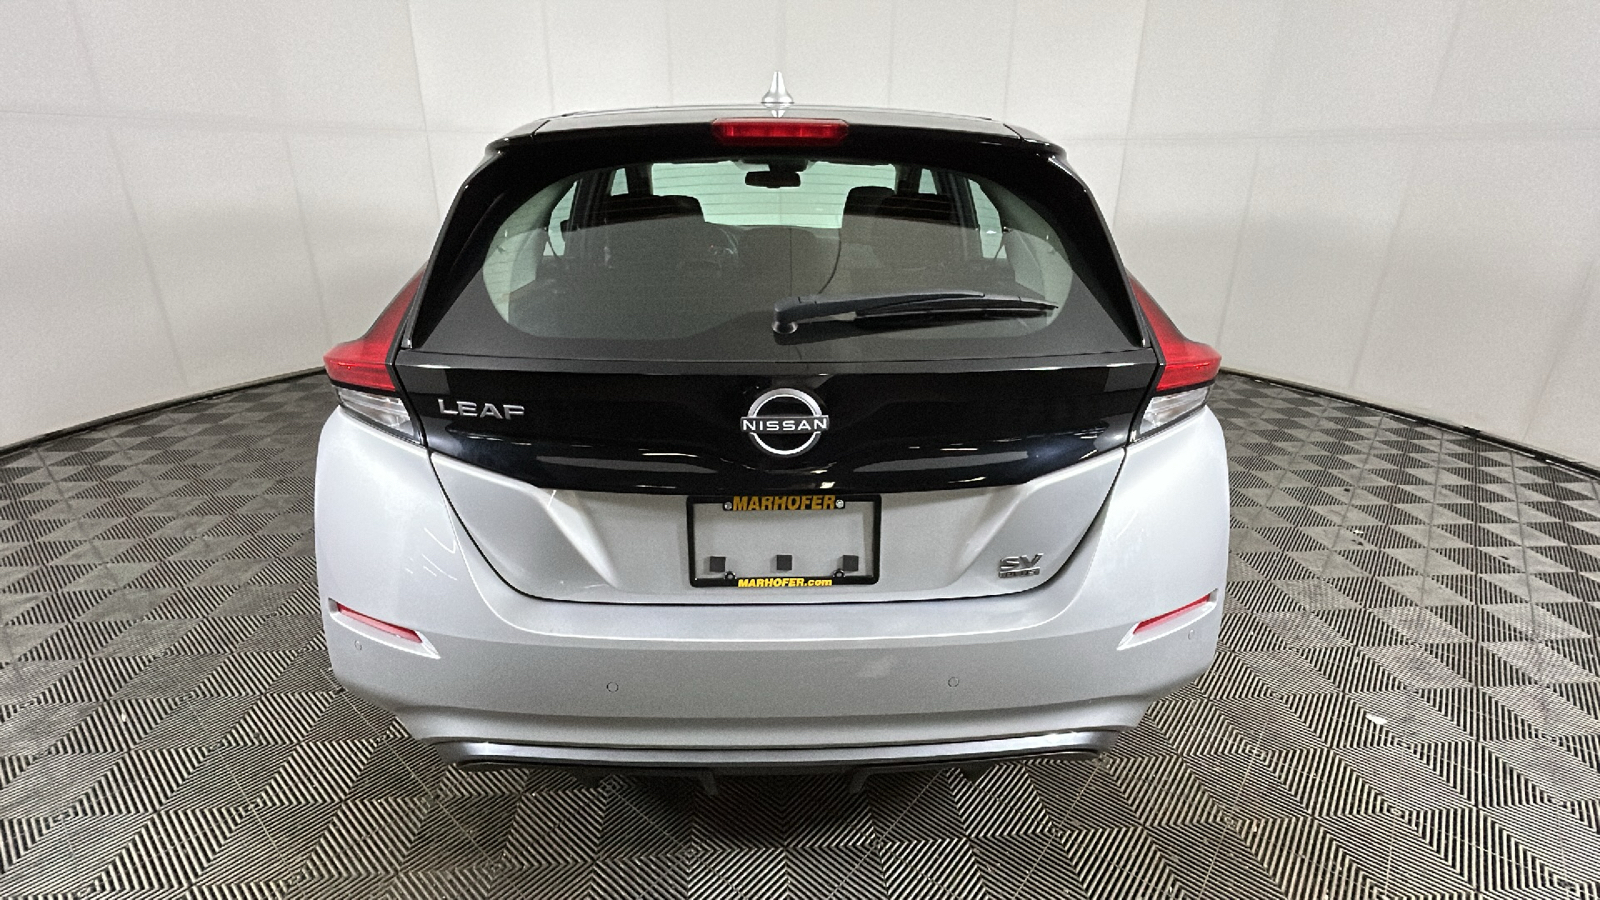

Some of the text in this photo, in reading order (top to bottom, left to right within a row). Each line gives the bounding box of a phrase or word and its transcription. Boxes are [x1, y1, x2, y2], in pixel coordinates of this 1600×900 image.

[437, 398, 525, 420] LEAF
[742, 418, 827, 431] NISSAN
[732, 495, 836, 511] MARHOFER
[999, 552, 1044, 571] SV
[737, 577, 832, 588] MARHOFER.com
